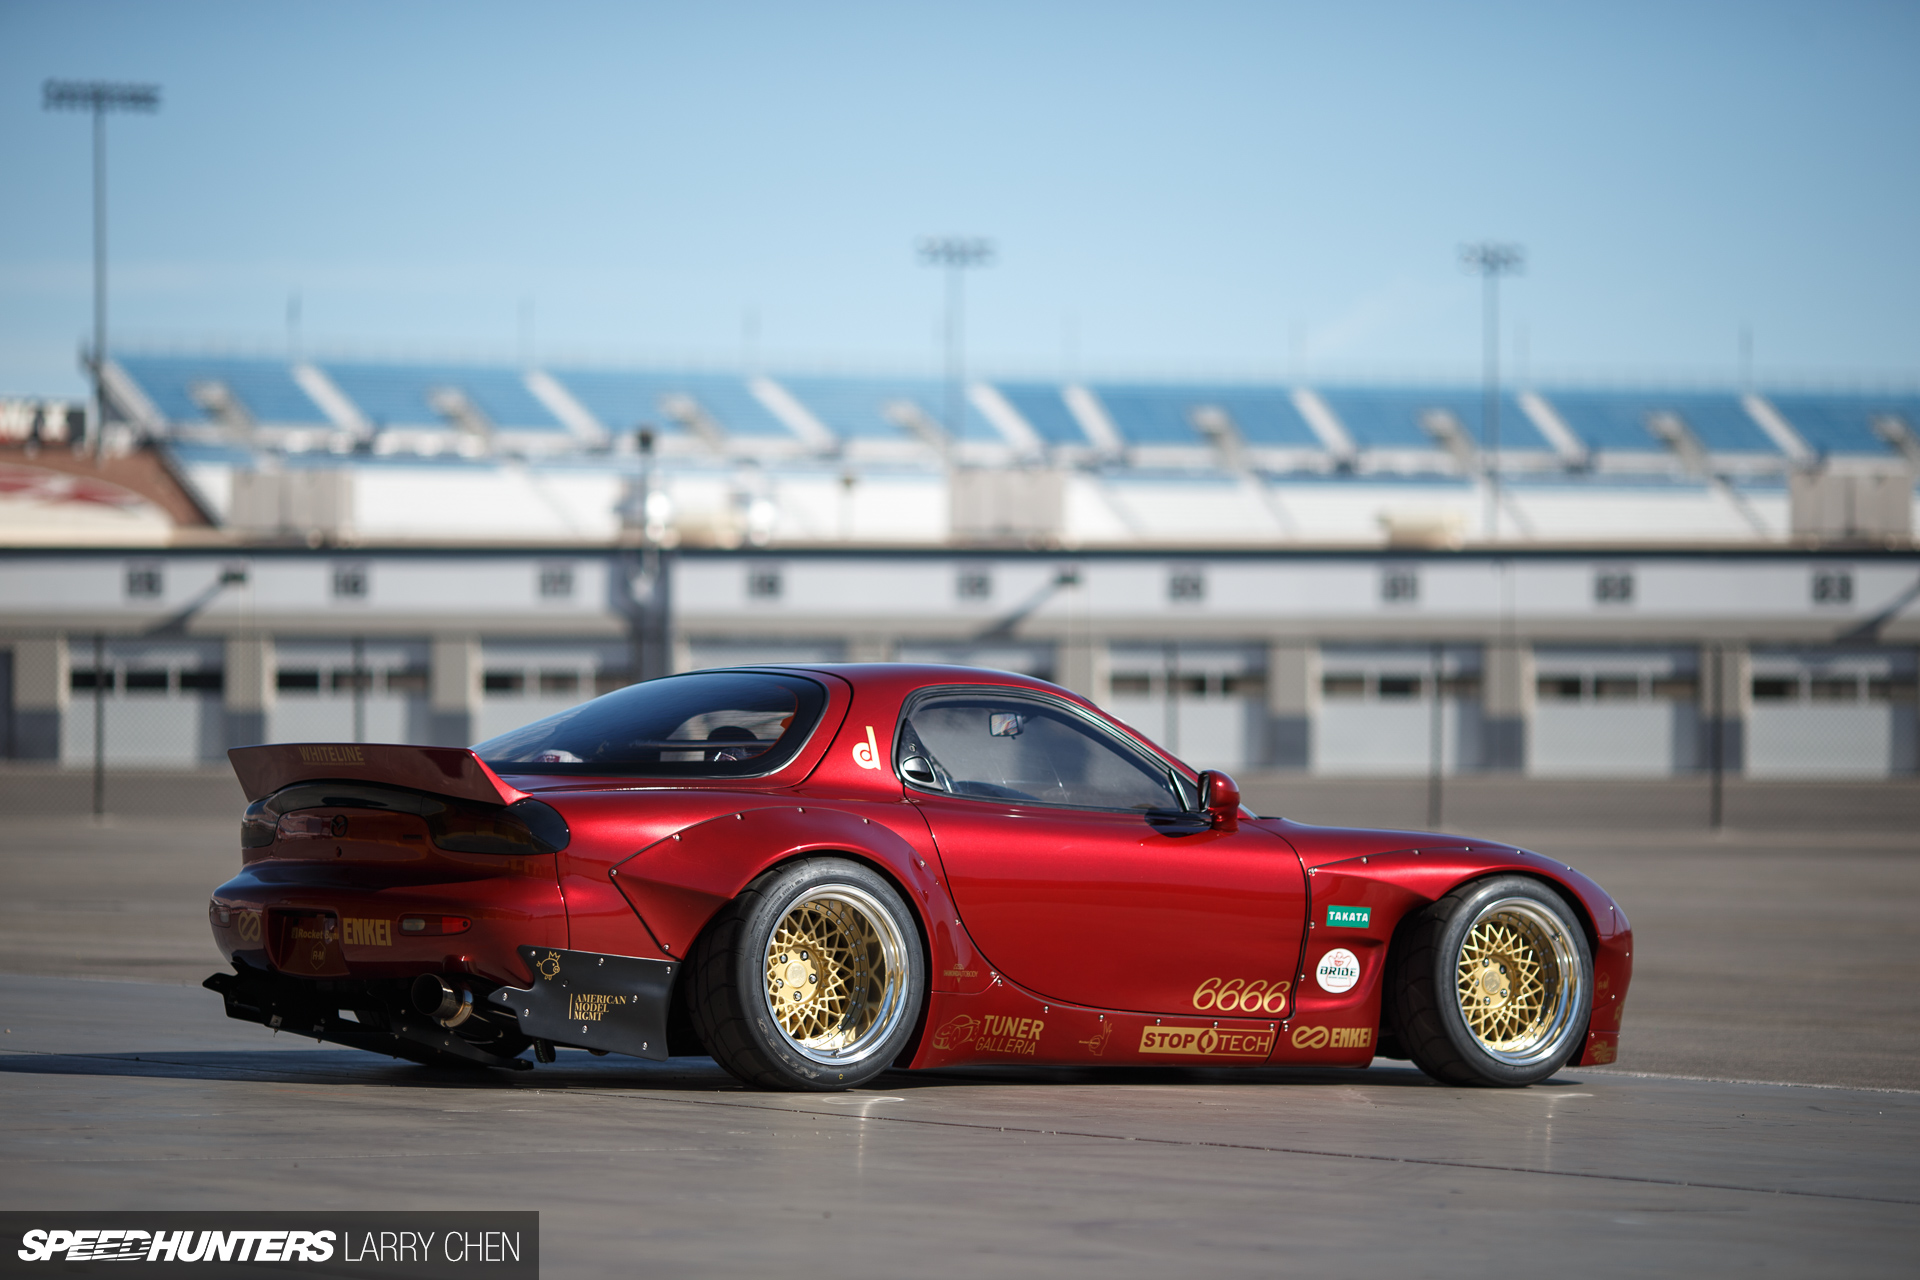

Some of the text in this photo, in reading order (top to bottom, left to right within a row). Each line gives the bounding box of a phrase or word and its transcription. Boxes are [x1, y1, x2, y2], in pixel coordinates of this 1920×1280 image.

[298, 746, 365, 762] WHITELINE
[1328, 911, 1369, 923] TAKATA
[298, 928, 324, 940] Rocket
[342, 917, 392, 946] ENKEI
[1319, 966, 1357, 977] BRIDE
[574, 993, 627, 1005] AMERICAN
[1192, 977, 1291, 1013] 6666
[574, 1002, 610, 1013] MODEL
[573, 1010, 604, 1022] MGMT
[983, 1014, 1045, 1041] TUNER
[1329, 1027, 1373, 1048] ENKEI
[975, 1036, 1036, 1056] GALLERIA
